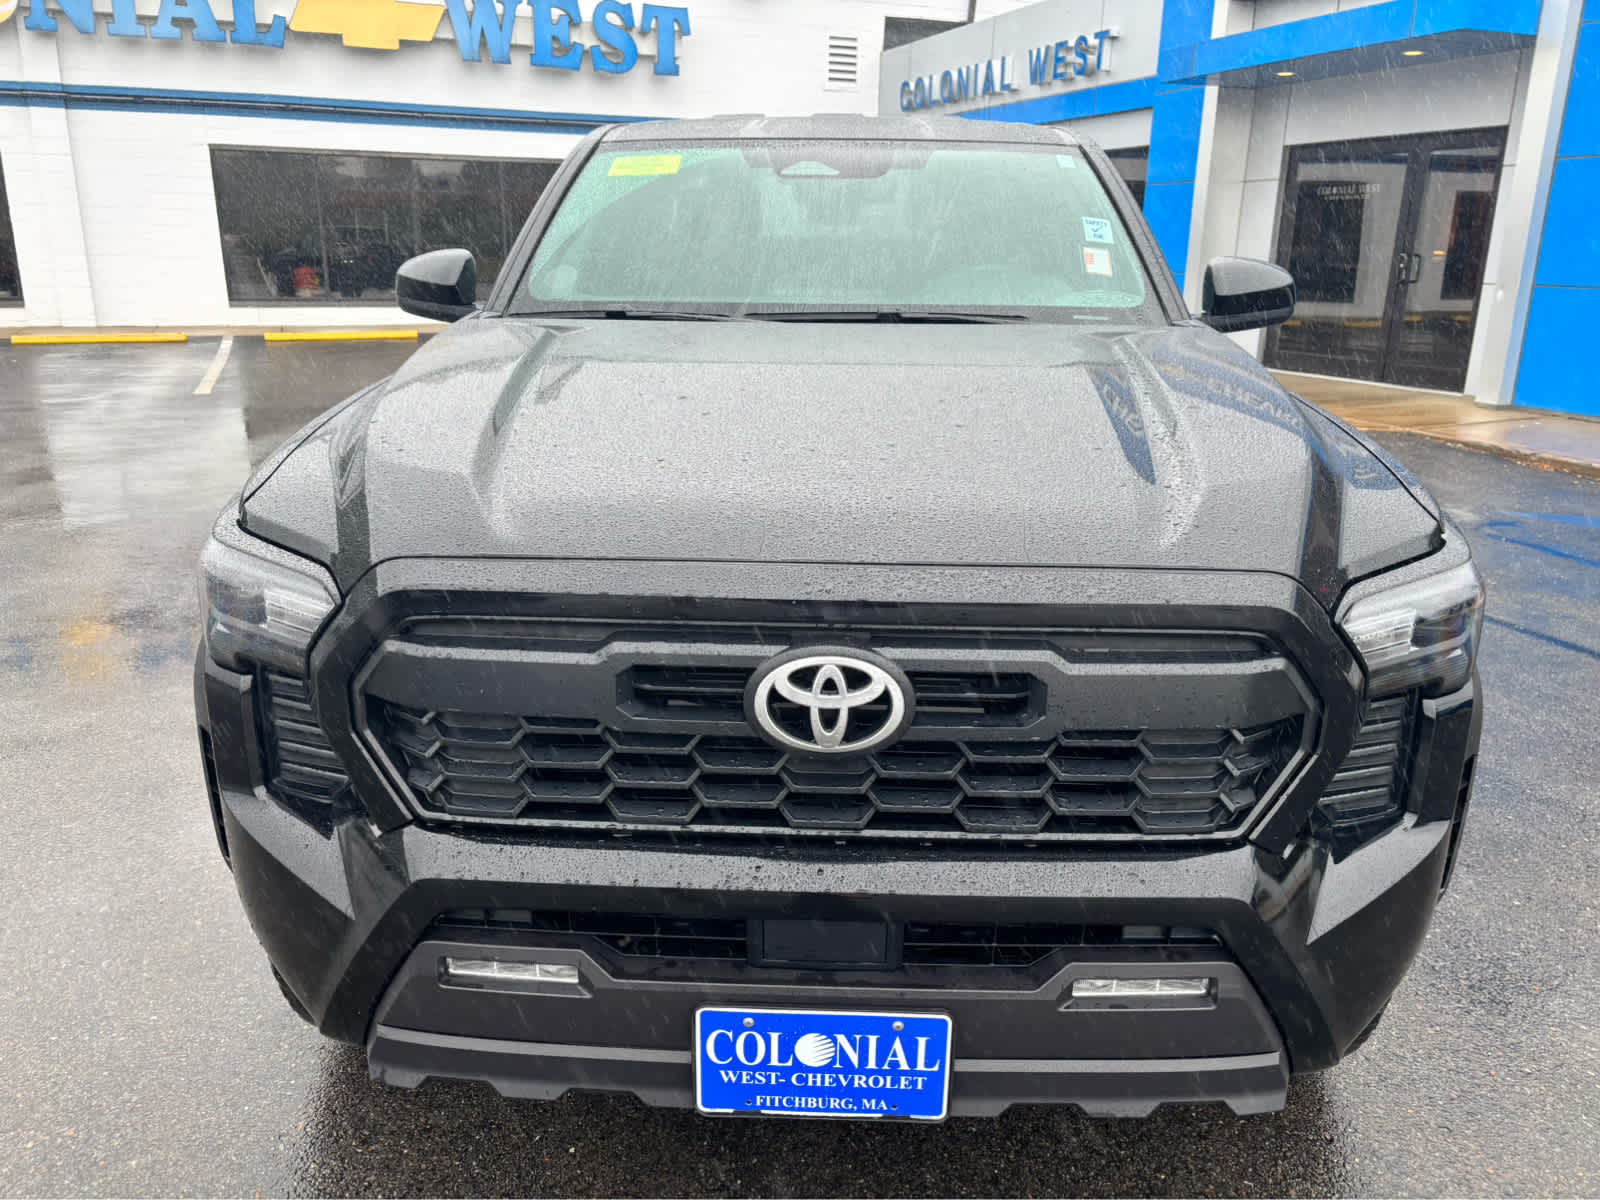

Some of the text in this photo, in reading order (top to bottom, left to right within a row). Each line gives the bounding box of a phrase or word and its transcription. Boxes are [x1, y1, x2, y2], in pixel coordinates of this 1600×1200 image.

[444, 0, 692, 76] WEST
[899, 29, 1114, 113] COLONIAL WEST
[705, 1029, 940, 1071] COLONIAL
[719, 1070, 927, 1090] WEST- CHEVROLET
[756, 1095, 888, 1111] FITCHBURG, MA
